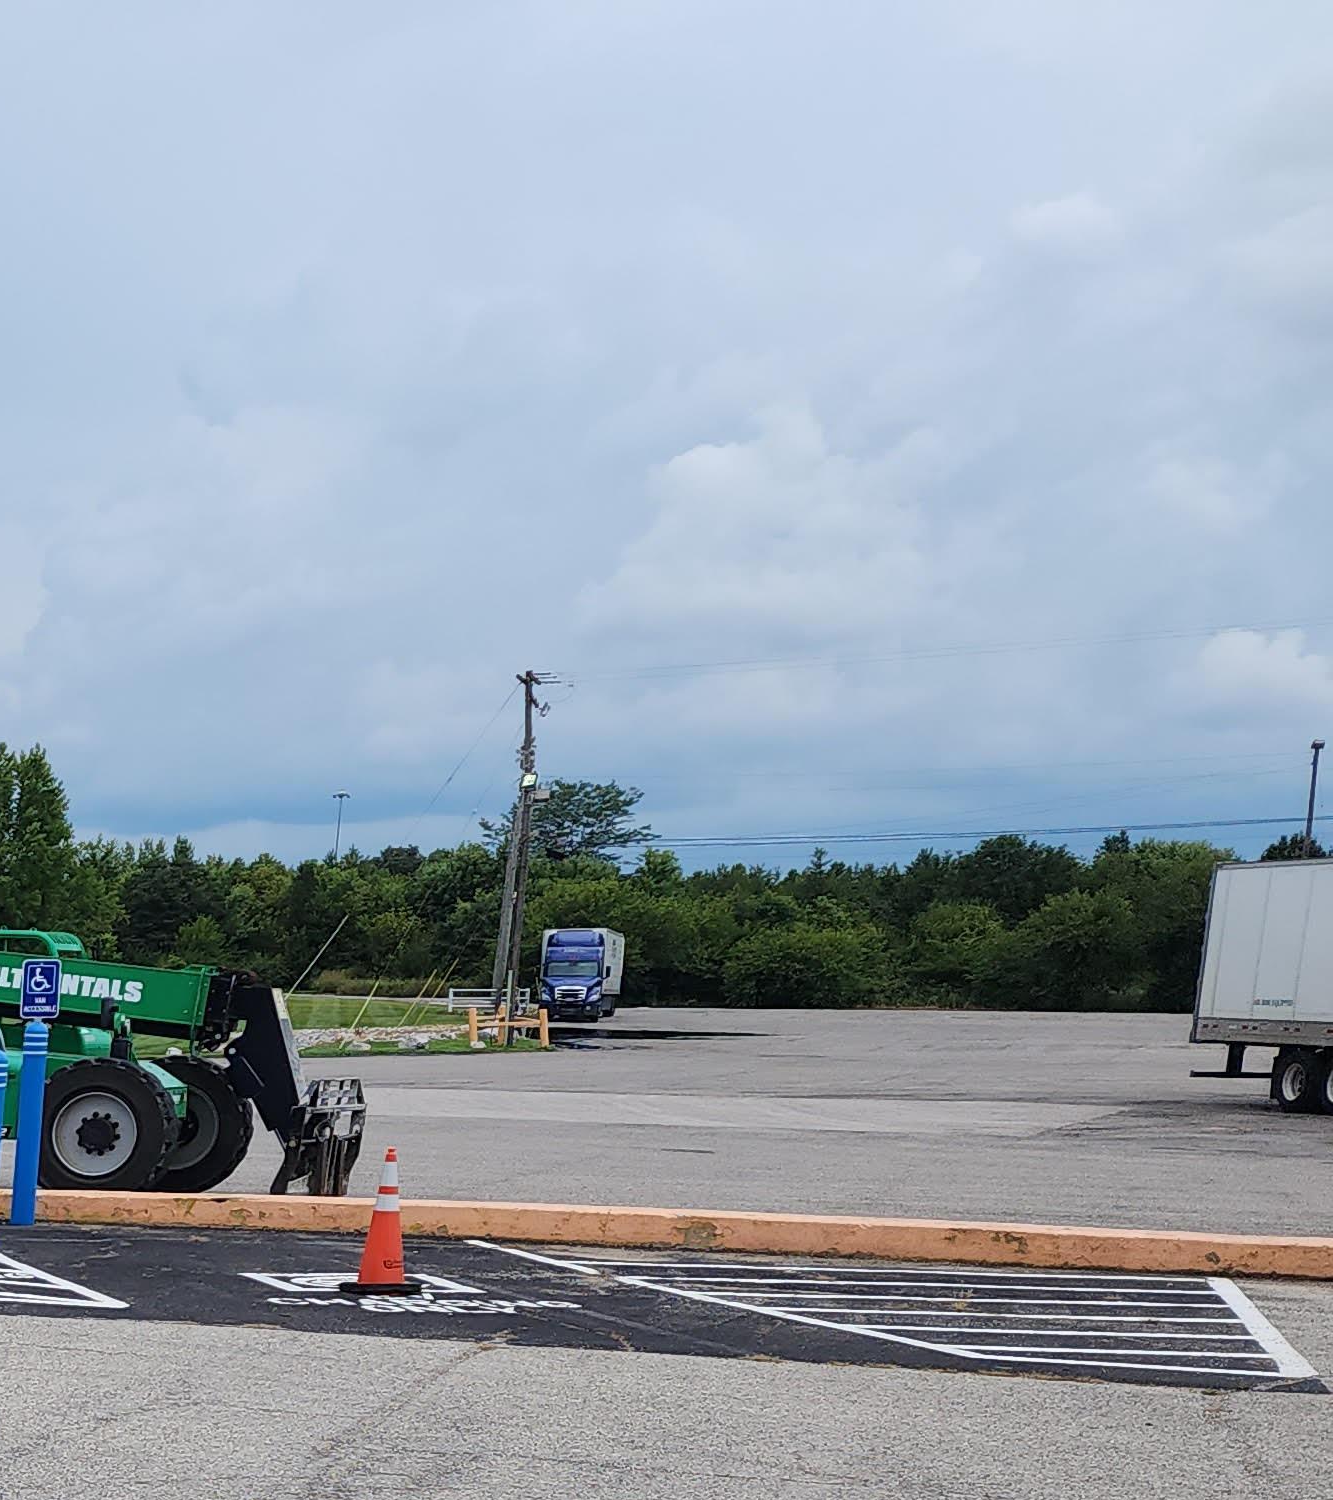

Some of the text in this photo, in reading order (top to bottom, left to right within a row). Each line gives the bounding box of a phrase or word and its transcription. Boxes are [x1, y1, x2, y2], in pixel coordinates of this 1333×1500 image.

[60, 974, 143, 1003] NTALS
[267, 1297, 583, 1308] CHARGING
[361, 1305, 516, 1314] ONLY
